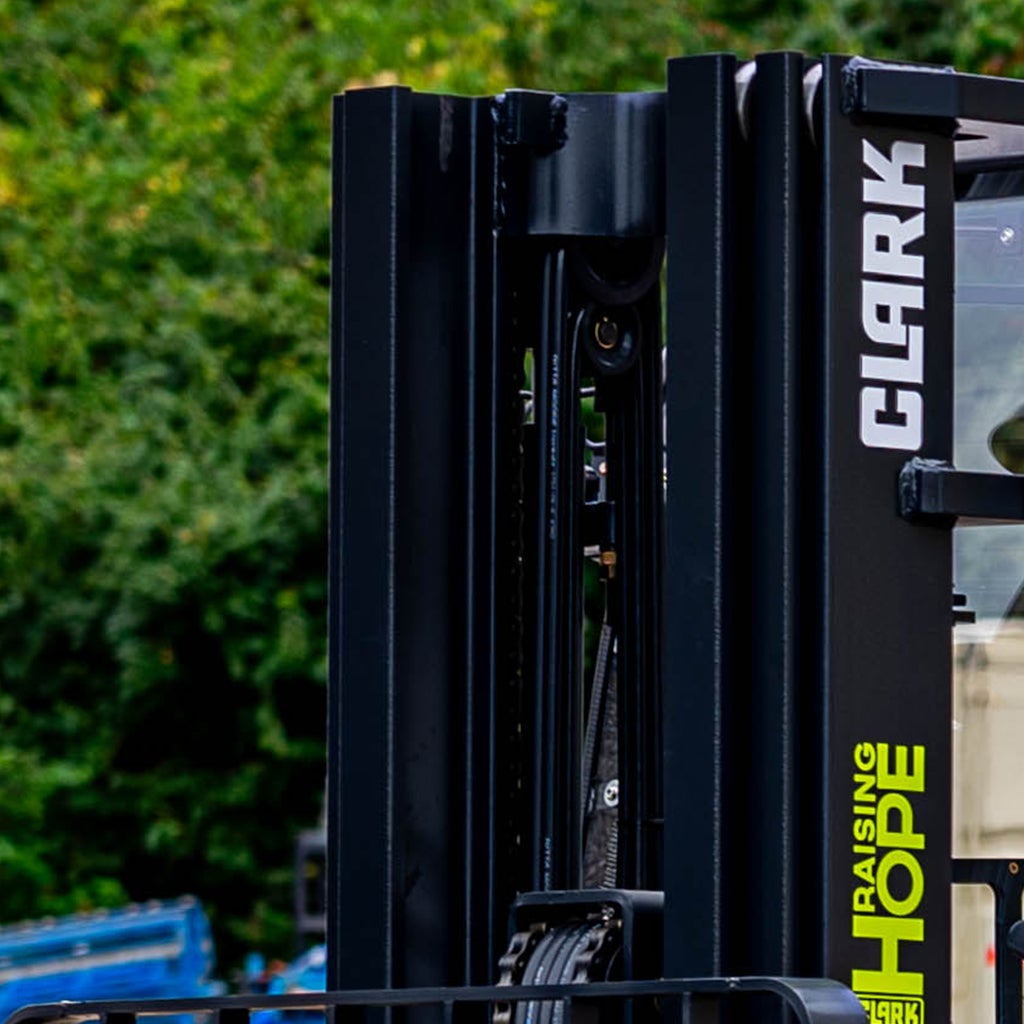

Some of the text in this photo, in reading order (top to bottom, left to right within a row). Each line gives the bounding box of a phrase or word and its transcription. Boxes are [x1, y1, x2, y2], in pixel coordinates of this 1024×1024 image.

[860, 138, 925, 451] CLARK
[851, 742, 925, 995] HOPE
[852, 742, 877, 912] RAISING
